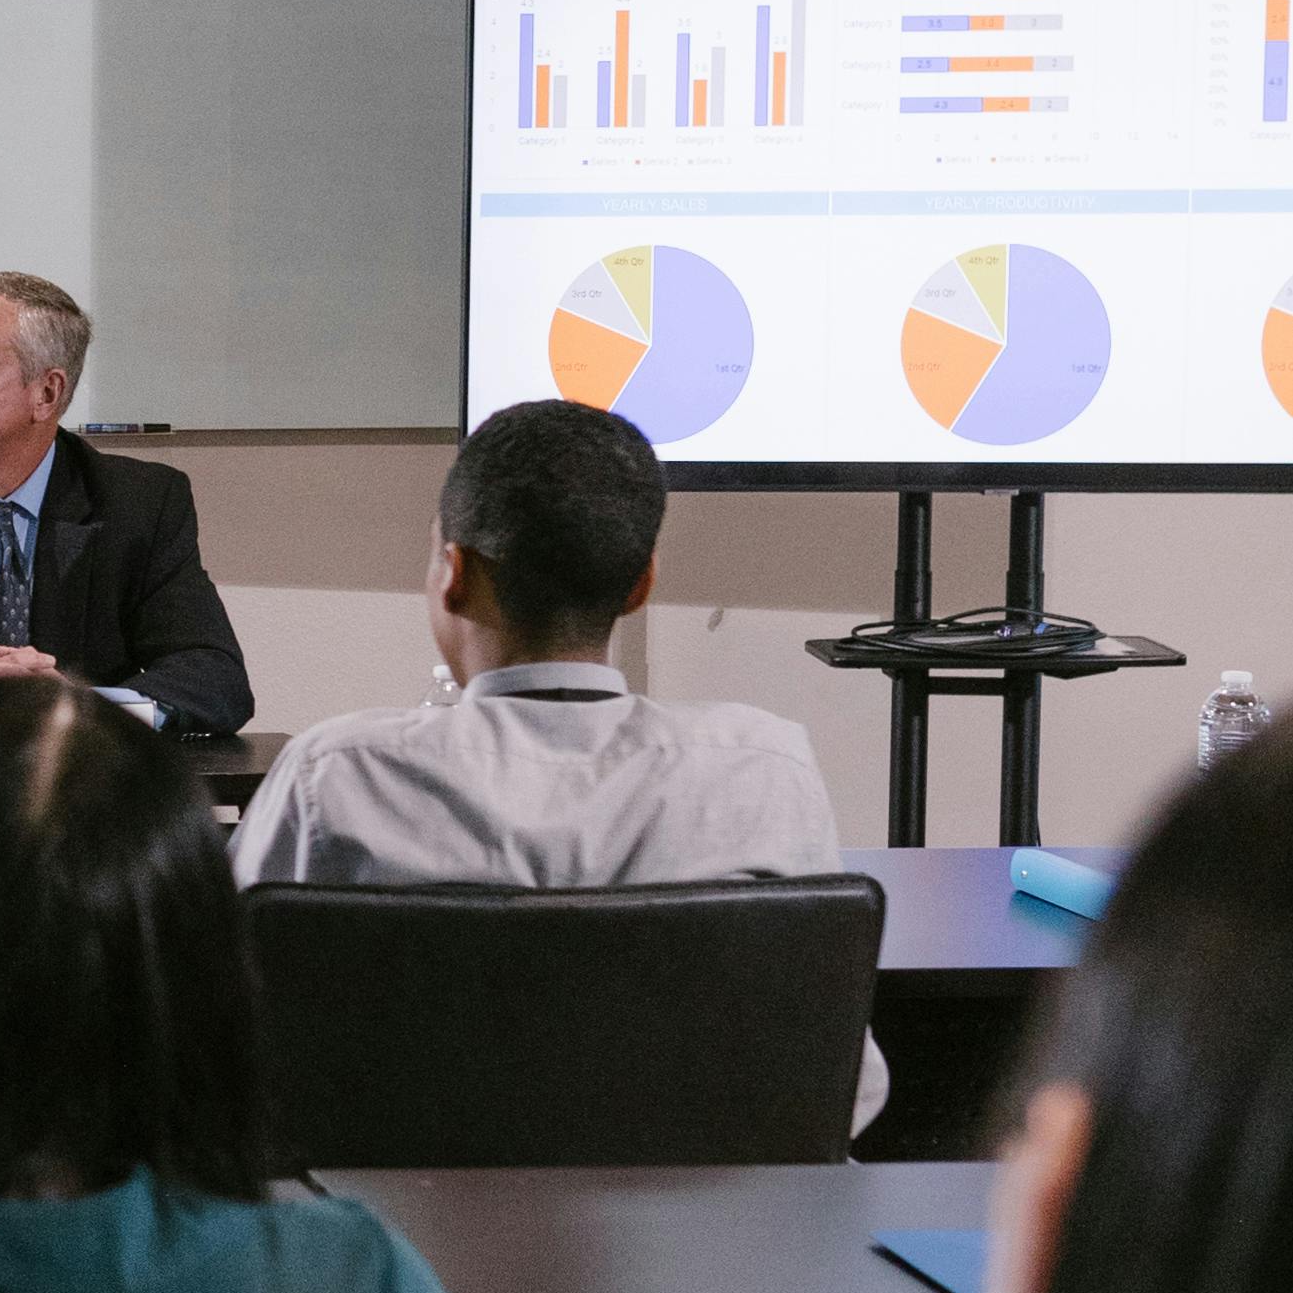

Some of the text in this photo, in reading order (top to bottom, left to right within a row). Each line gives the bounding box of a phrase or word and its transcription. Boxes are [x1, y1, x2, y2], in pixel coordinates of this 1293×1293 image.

[843, 18, 883, 30] Category
[842, 60, 882, 71] Category
[841, 100, 881, 111] Category
[518, 136, 557, 147] Category
[596, 136, 634, 146] Category
[676, 135, 715, 146] Category
[600, 198, 707, 212] YEARLY SALES
[924, 195, 1095, 210] YEARLY PRODUCTIVITY
[614, 257, 645, 267] 4th Qtr
[968, 255, 999, 266] 4th Qtr
[572, 289, 603, 299] 3rd Qtr
[924, 288, 956, 298] 3rd Qtr
[573, 362, 588, 373] Qtr
[716, 363, 746, 374] 1st Qtr
[925, 362, 940, 372] Qtr
[1071, 363, 1102, 374] 1st Qtr
